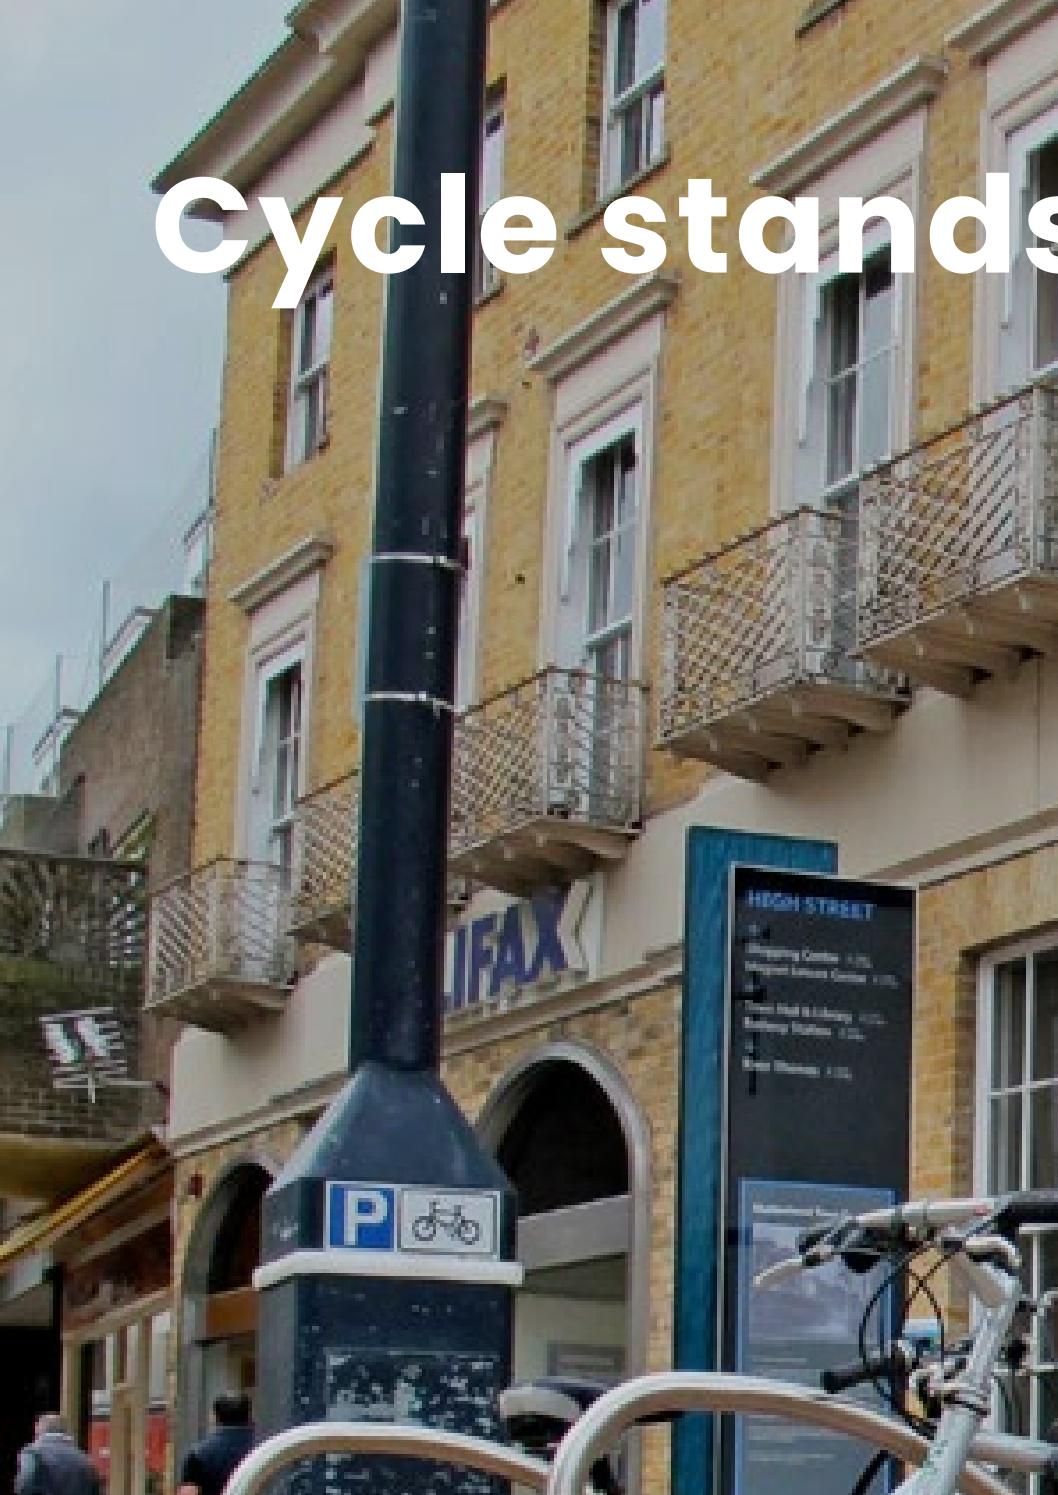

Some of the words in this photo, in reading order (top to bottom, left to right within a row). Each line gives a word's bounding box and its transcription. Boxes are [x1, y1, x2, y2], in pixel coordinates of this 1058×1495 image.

[747, 889, 799, 911] HIGH
[806, 897, 877, 920] STREET
[444, 888, 569, 1012] IFAX
[344, 1190, 389, 1246] P
